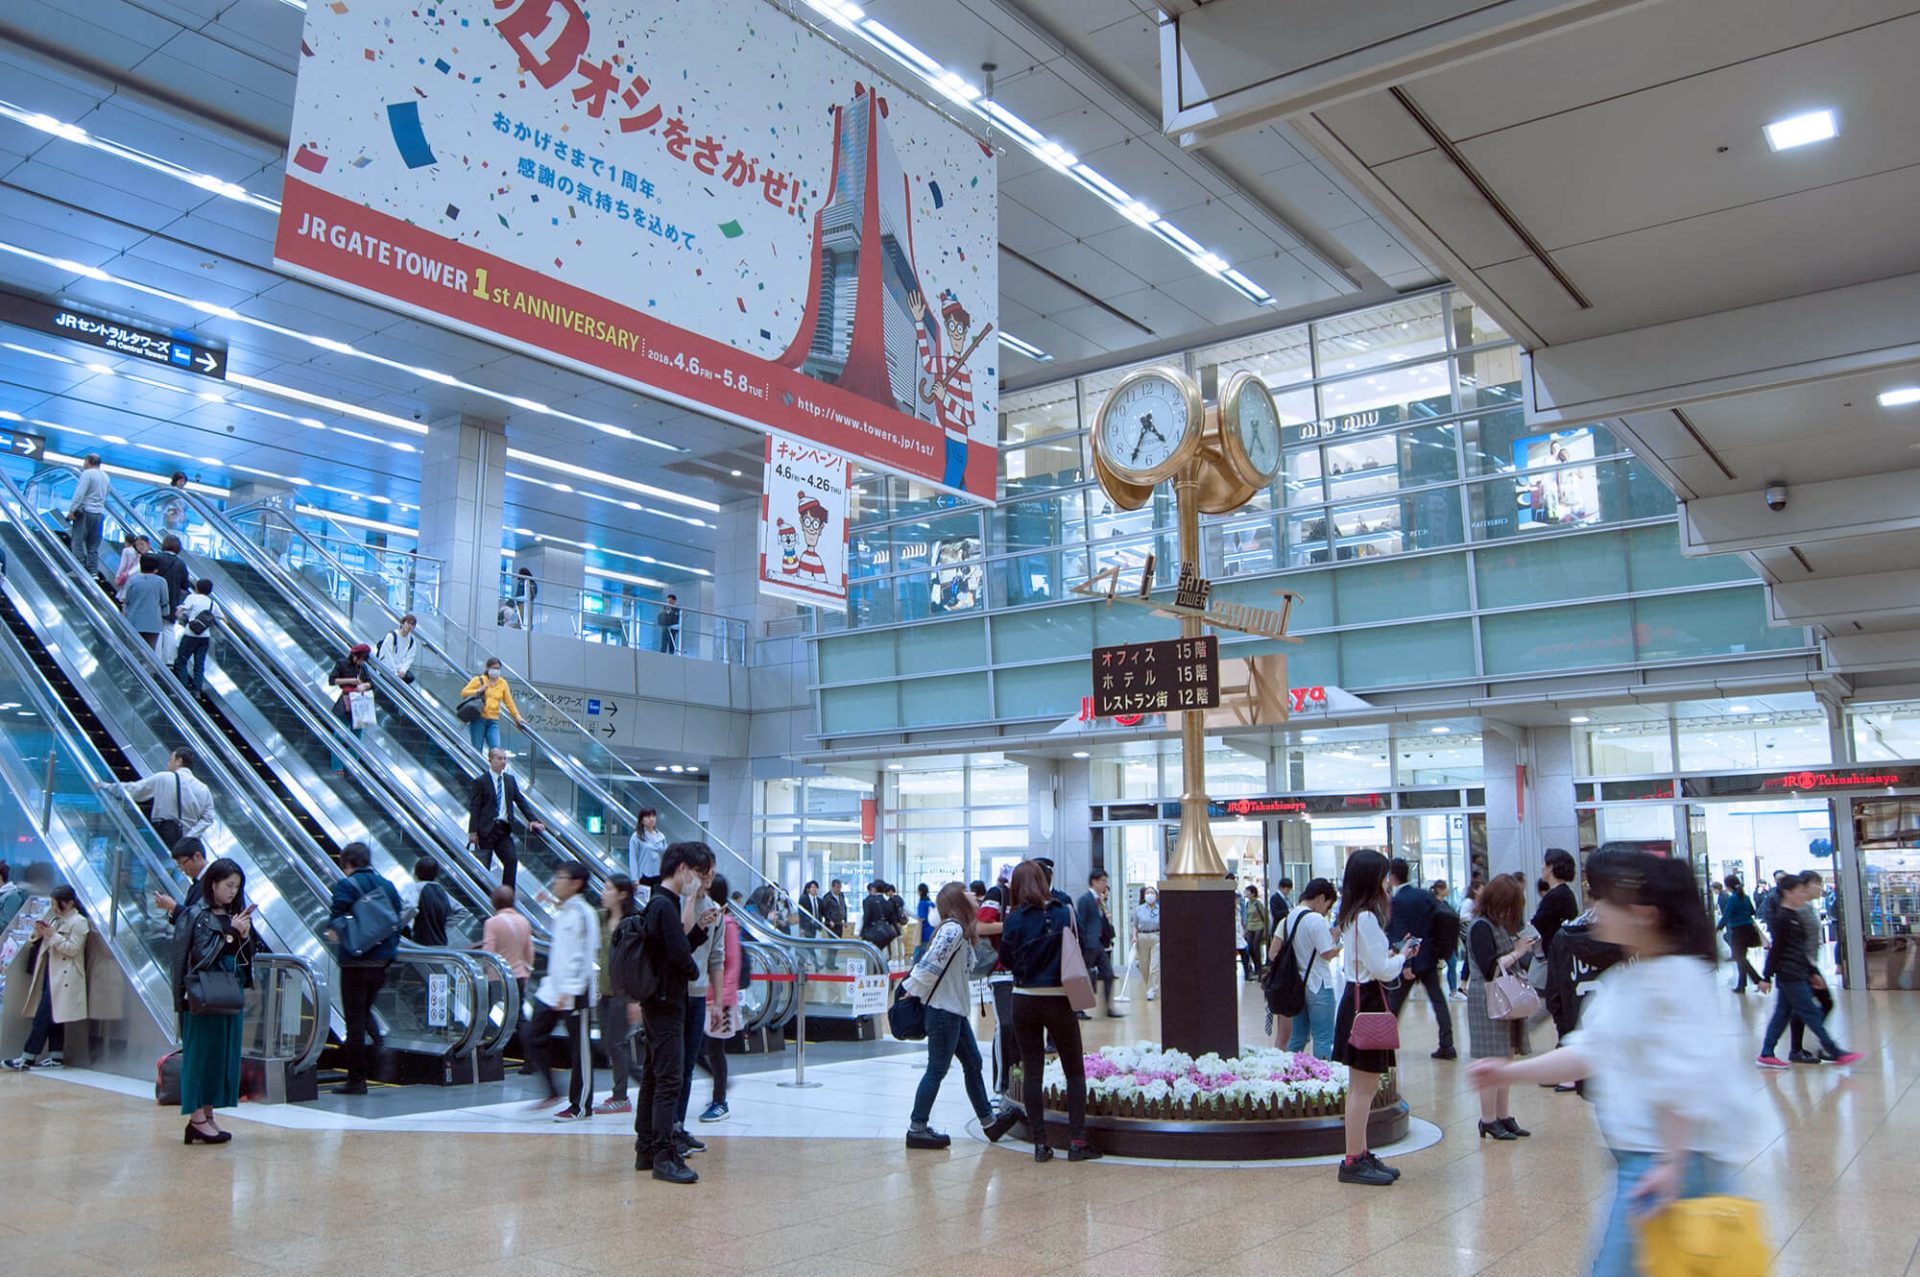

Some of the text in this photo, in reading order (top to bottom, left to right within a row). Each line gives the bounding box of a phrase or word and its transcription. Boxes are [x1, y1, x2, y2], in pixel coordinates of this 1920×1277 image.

[297, 212, 640, 353] JR GATE TOWER 1st ANNIVERSARY
[56, 313, 171, 354] JRセントラルタワーズ
[106, 339, 169, 361] JR Central Towers
[797, 397, 934, 457] http://www.towers.jp/1st/
[777, 441, 843, 472] キャンペーン!
[1176, 590, 1207, 608] TOWER
[1102, 647, 1155, 668] オフィス
[1103, 669, 1156, 690] ホテル
[1103, 690, 1168, 711] レストラン街
[1782, 772, 1900, 788] JR Takashimaya
[1250, 800, 1306, 812] Takashimaya
